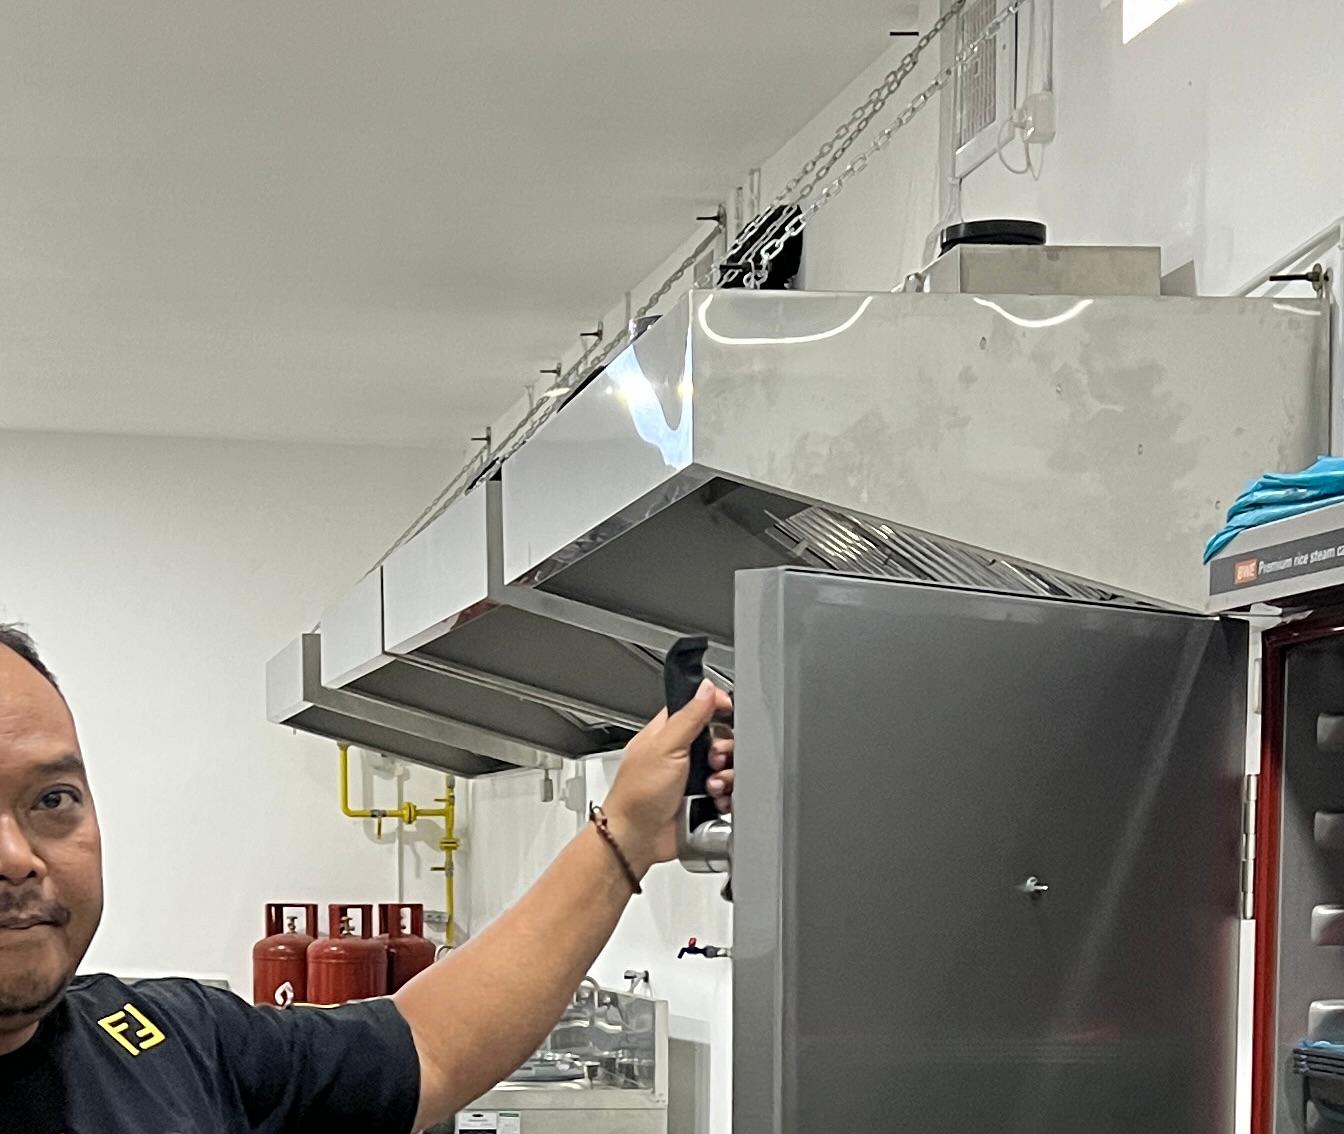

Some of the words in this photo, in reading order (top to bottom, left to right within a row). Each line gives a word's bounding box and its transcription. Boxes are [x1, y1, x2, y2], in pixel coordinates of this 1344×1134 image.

[1258, 558, 1292, 575] Premium
[1293, 553, 1309, 566] rice
[1310, 547, 1336, 563] steam
